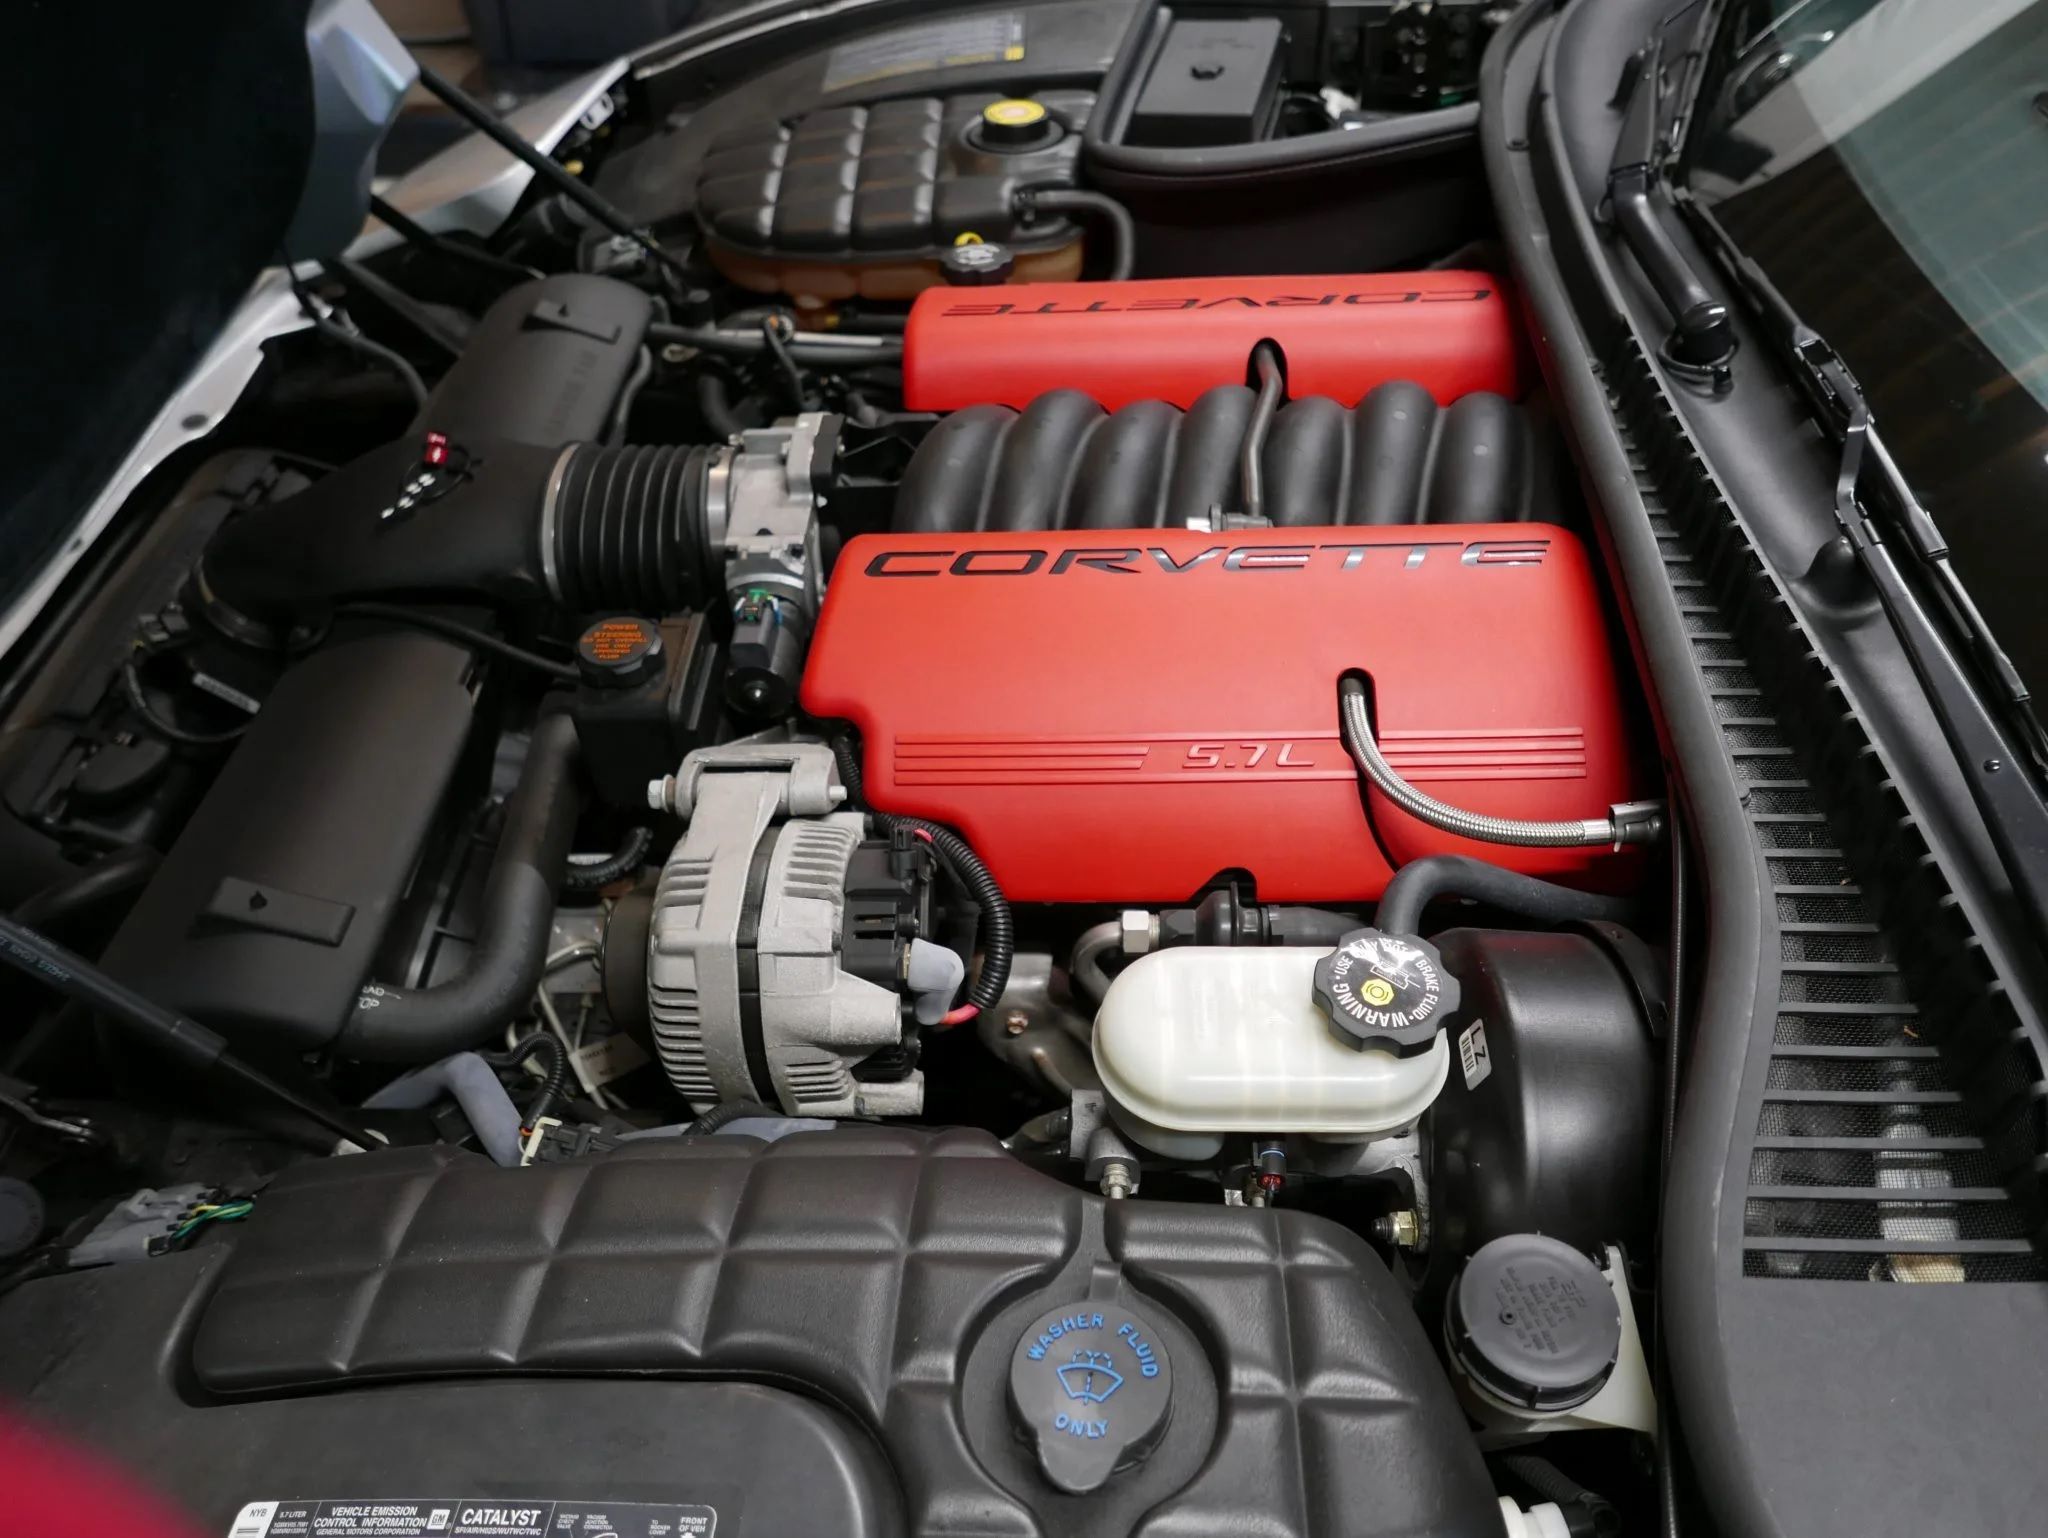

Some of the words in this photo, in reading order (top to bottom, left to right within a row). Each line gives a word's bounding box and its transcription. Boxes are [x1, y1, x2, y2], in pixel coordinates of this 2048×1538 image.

[943, 290, 1491, 316] CORVETTE
[864, 540, 1551, 577] CORVETTE
[1182, 743, 1315, 769] 5.7L
[1334, 955, 1354, 976] USE
[1415, 959, 1440, 992] BRAKE
[1332, 982, 1410, 1027] WARNING
[1412, 993, 1438, 1021] FLUID
[1027, 1312, 1104, 1361] WASHER
[1117, 1322, 1160, 1379] FLUID
[1055, 1413, 1108, 1438] ONLY
[314, 1517, 357, 1527] CONTROL
[362, 1517, 427, 1527] INFORMATION
[331, 1506, 371, 1517] VEHICLE
[372, 1506, 418, 1516] EMISSION
[461, 1508, 542, 1526] CATALYST
[680, 1517, 708, 1525] FRONT
[374, 1528, 421, 1536] CORPORATION
[690, 1525, 706, 1533] VEH
